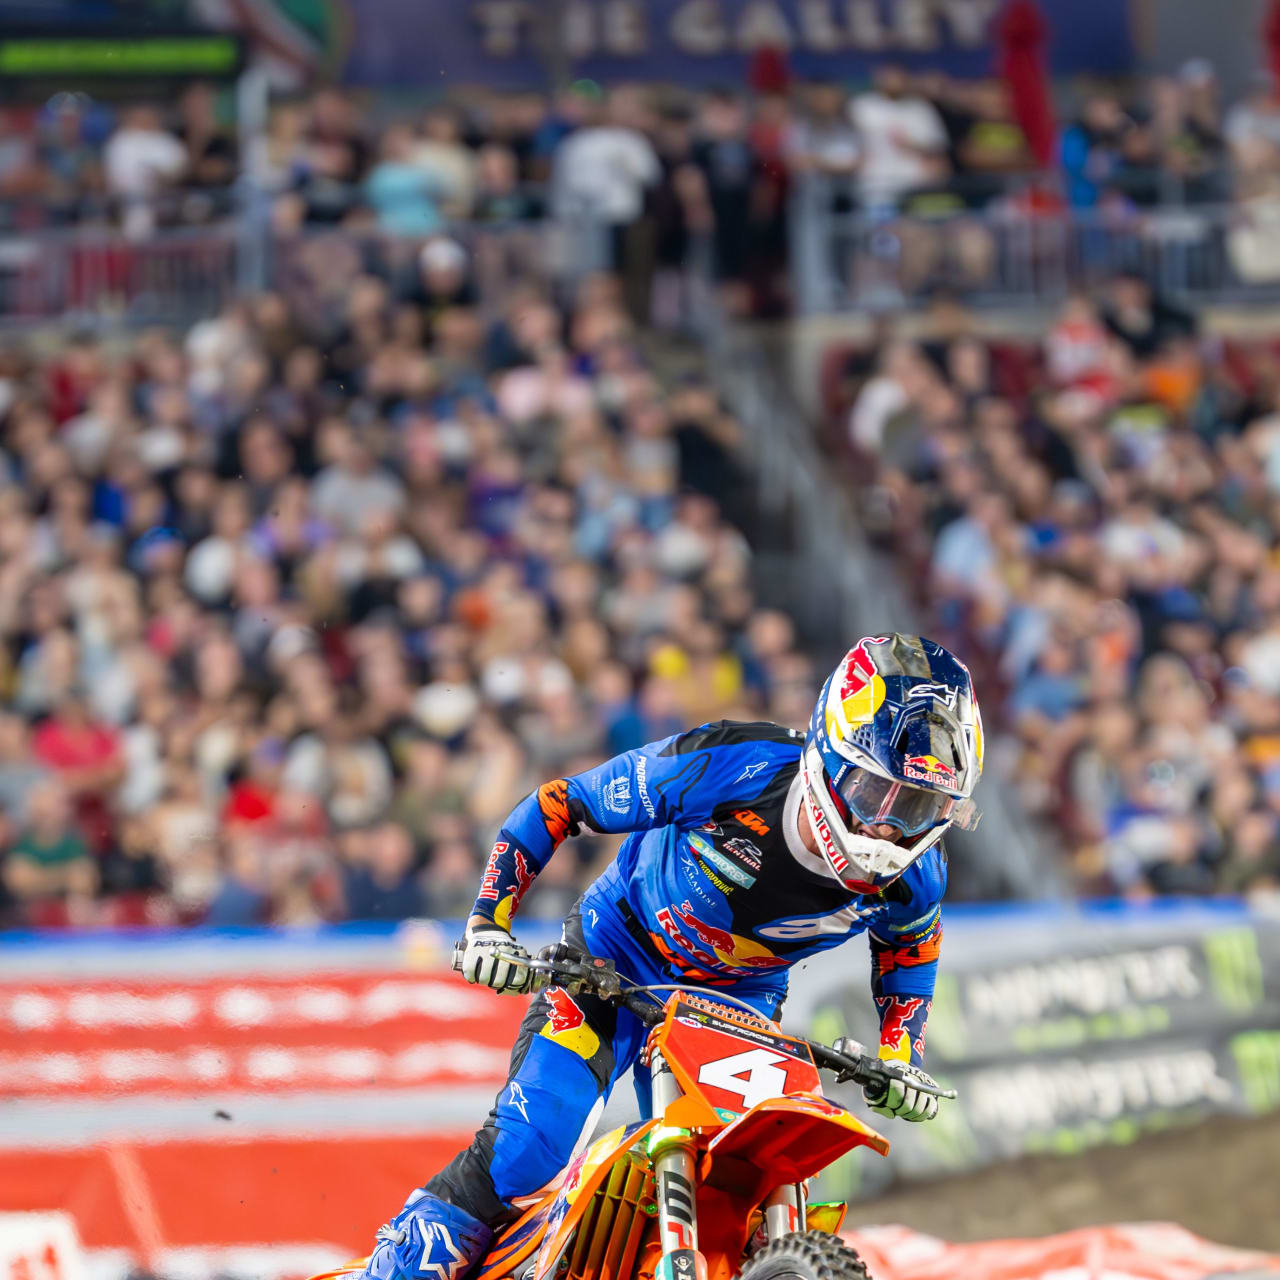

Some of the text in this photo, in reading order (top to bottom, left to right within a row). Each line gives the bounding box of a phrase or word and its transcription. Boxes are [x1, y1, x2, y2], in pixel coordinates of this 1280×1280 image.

[904, 766, 958, 791] Red Bull
[730, 809, 770, 836] KTM
[484, 842, 510, 875] Red
[817, 821, 849, 875] Bull
[702, 847, 749, 885] MOTOREX
[698, 1049, 789, 1109] 4
